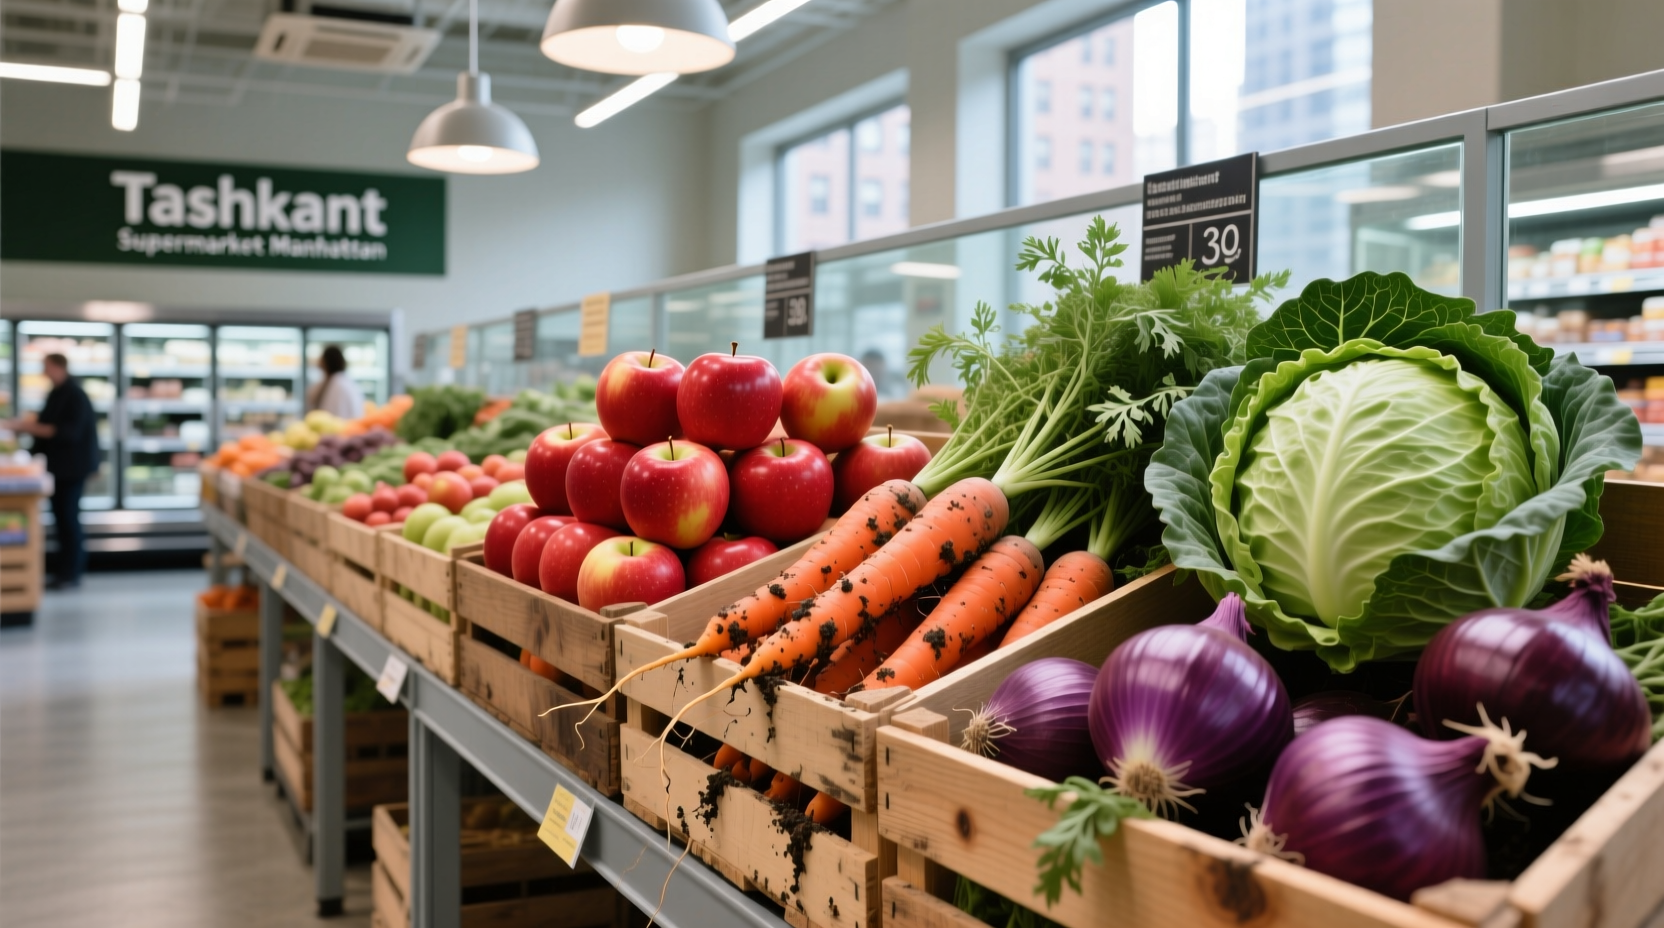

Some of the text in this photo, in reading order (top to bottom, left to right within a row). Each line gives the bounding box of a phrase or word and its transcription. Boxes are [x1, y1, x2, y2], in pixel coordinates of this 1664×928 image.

[110, 170, 387, 236] Tashkant
[117, 228, 387, 260] Supermarket Manhattan
